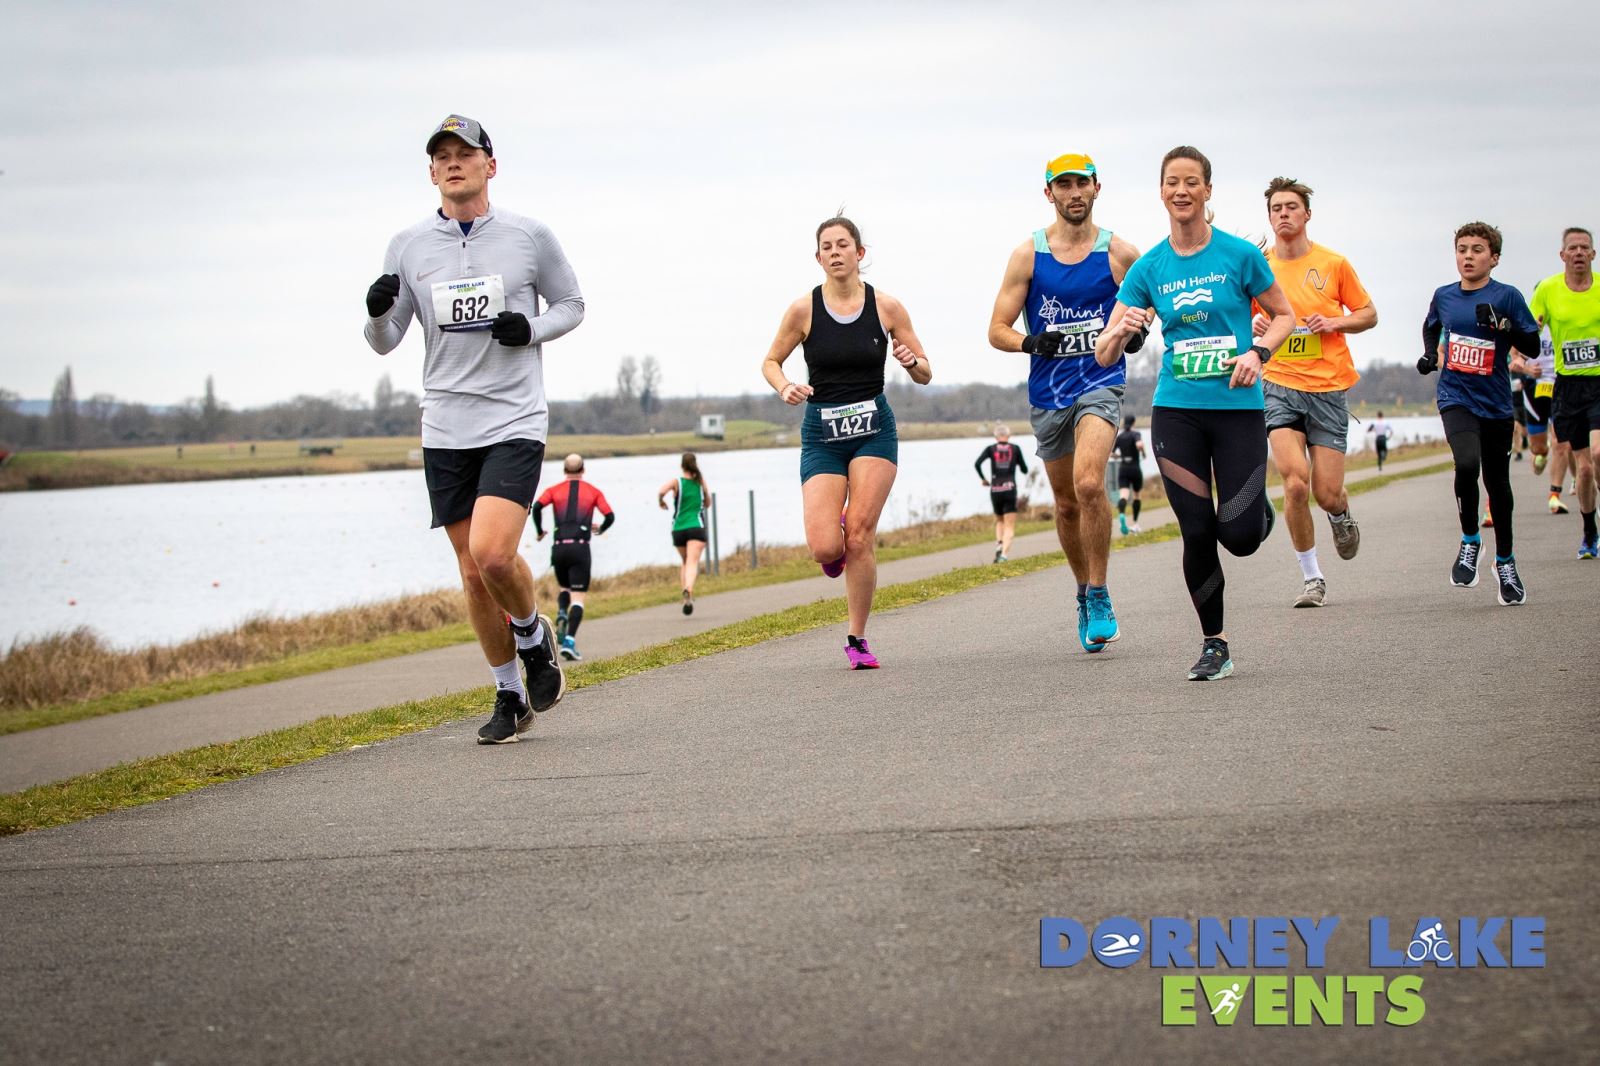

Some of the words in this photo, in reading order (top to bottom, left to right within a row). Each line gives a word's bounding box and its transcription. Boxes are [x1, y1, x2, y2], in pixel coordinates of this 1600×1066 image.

[1162, 279, 1187, 295] RUN
[1189, 272, 1228, 287] Henley
[452, 295, 489, 322] 632
[1060, 303, 1105, 320] mind
[1181, 310, 1209, 324] firefly
[1288, 337, 1306, 353] 121
[1451, 344, 1485, 367] 3001
[1564, 346, 1597, 362] 1165
[1181, 350, 1230, 373] 1778
[828, 412, 873, 437] 1427
